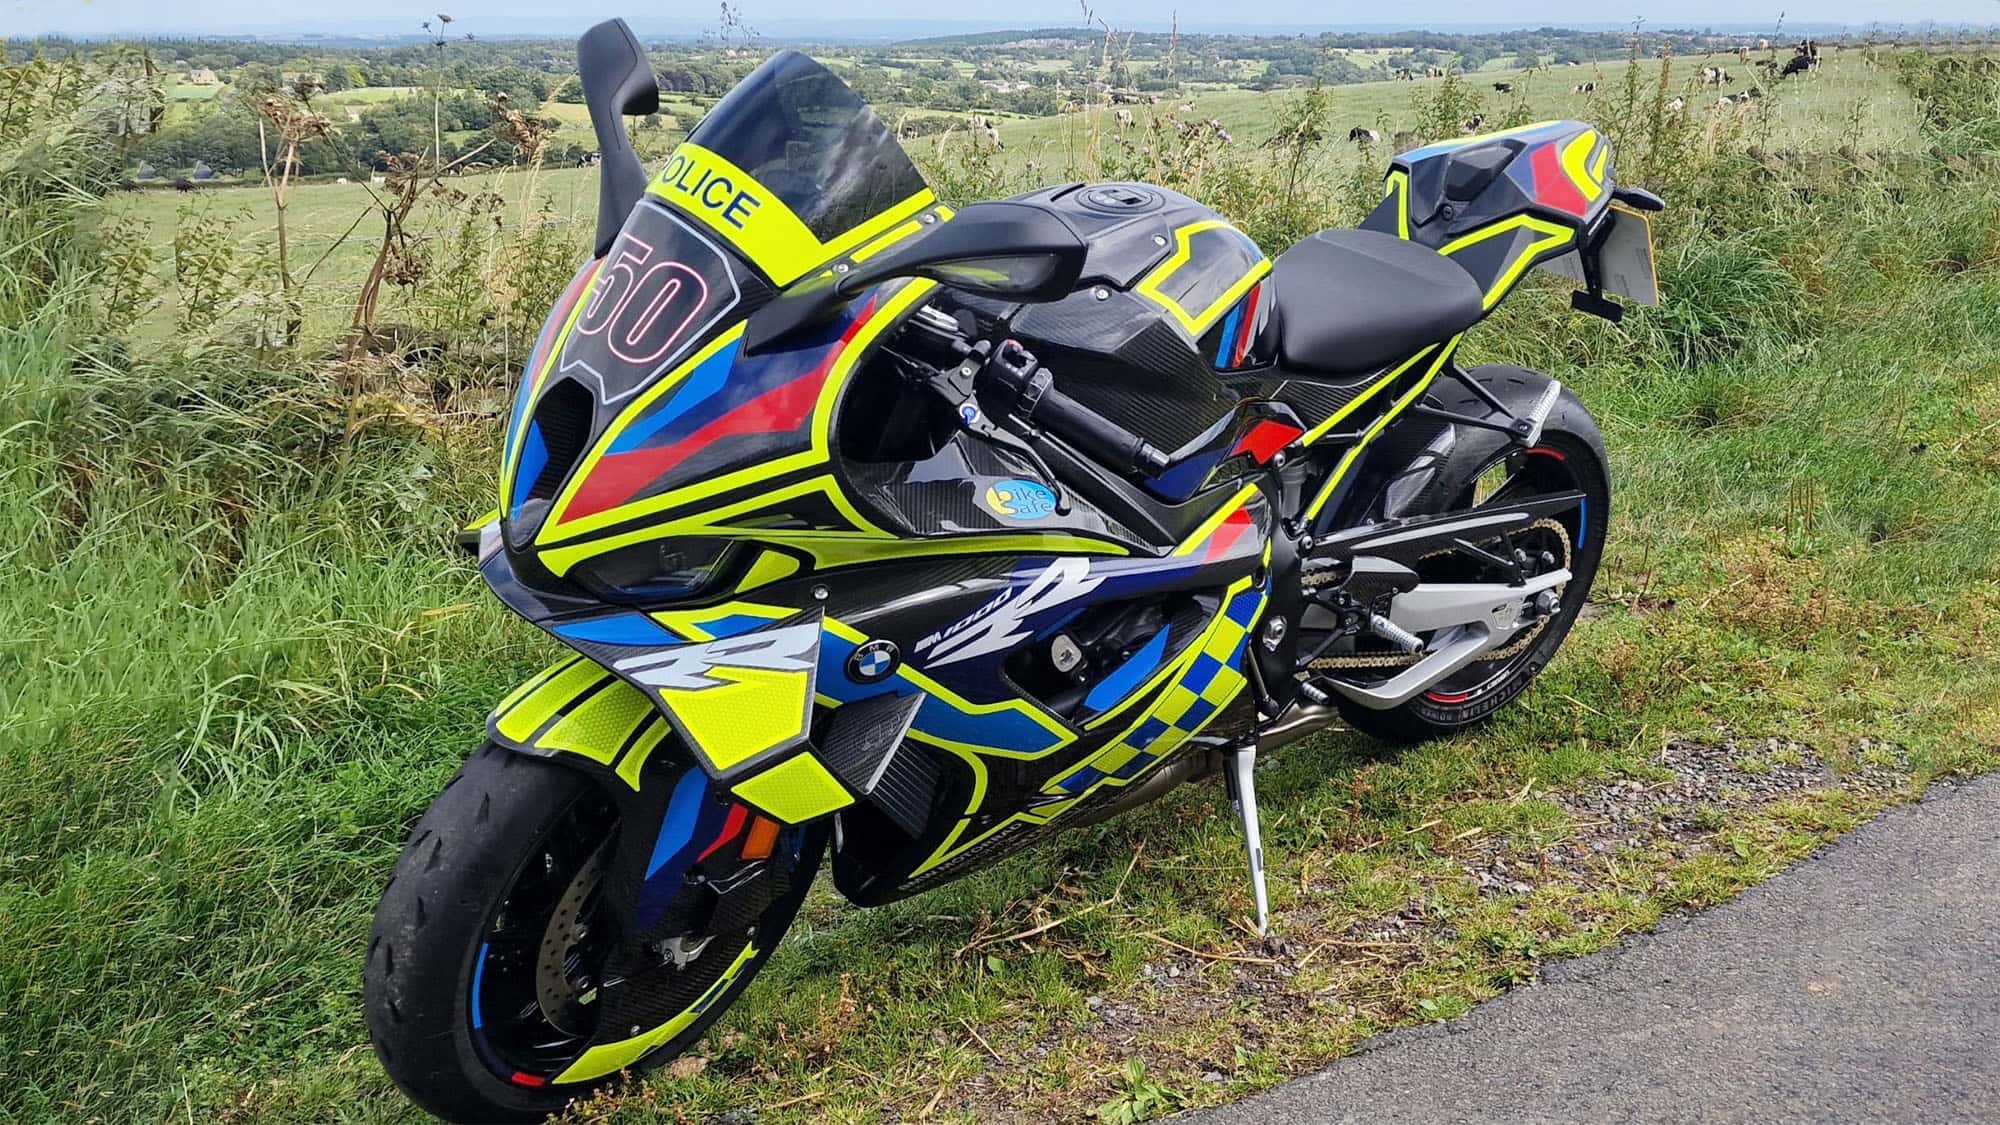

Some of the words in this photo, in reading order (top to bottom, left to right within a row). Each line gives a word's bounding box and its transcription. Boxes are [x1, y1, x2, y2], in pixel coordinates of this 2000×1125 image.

[661, 155, 761, 230] OLICE
[577, 233, 708, 363] 50
[854, 644, 896, 662] BMW
